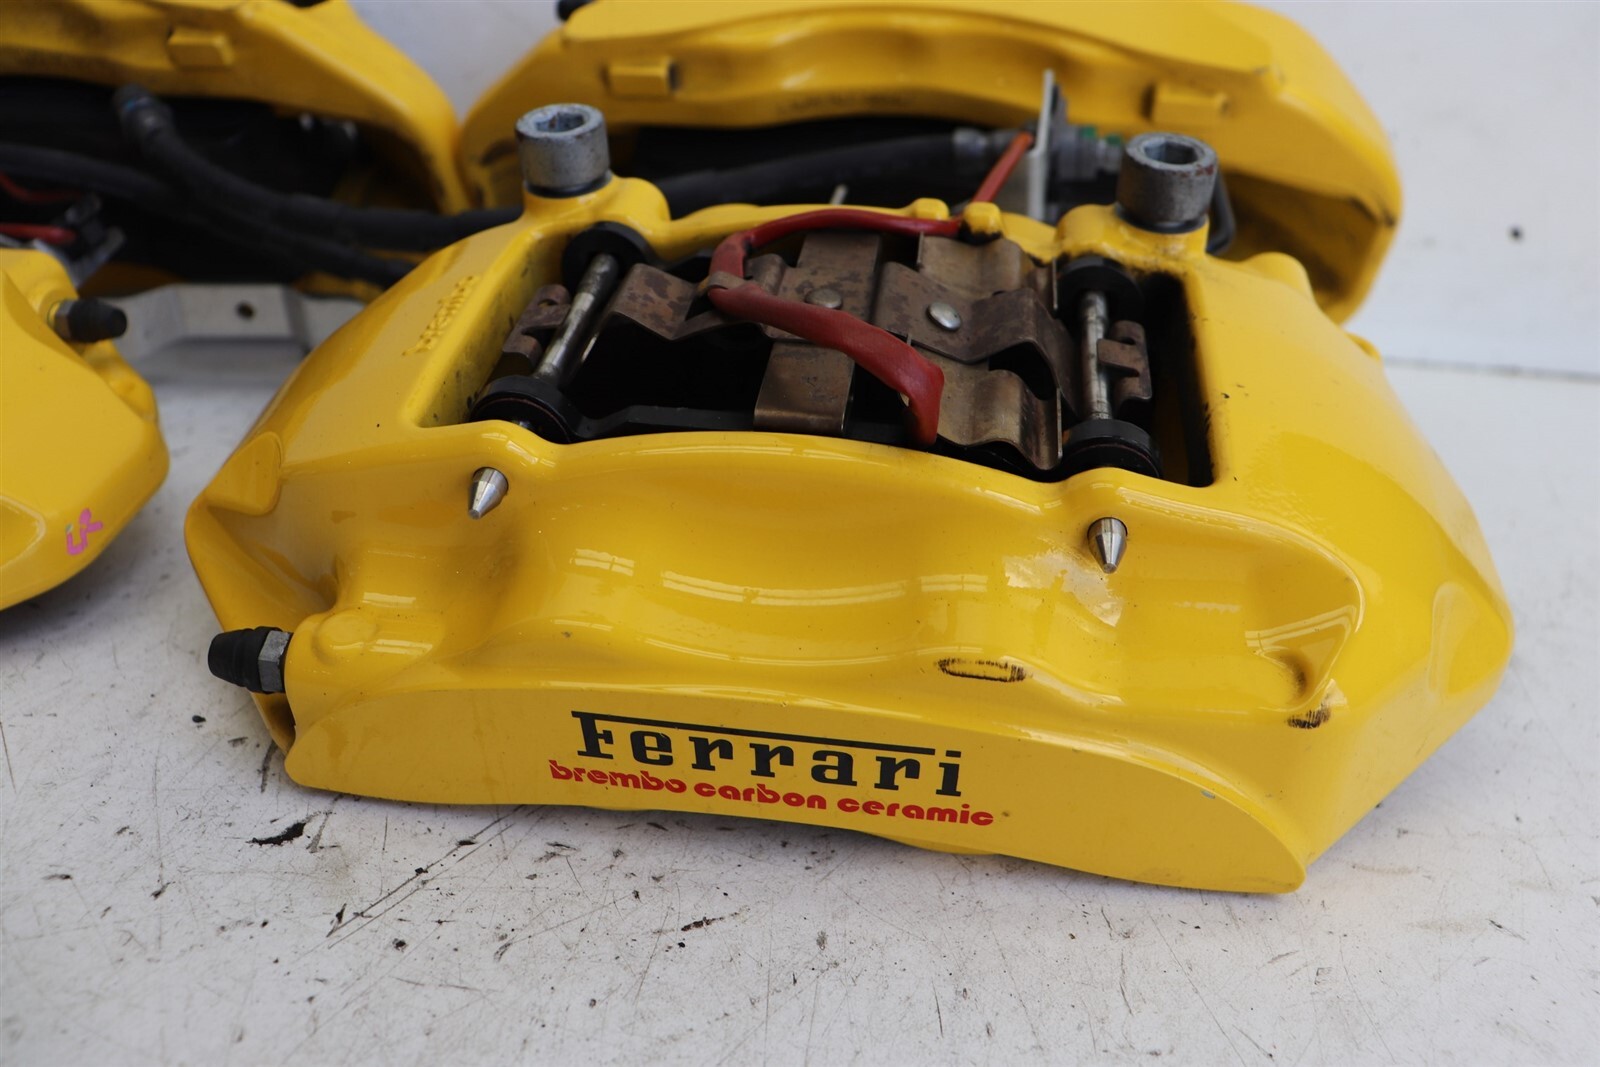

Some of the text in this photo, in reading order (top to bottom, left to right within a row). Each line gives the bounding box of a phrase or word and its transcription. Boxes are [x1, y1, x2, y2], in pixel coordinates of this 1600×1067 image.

[571, 711, 962, 797] Ferrari
[548, 759, 994, 826] brembo carbon ceramic
